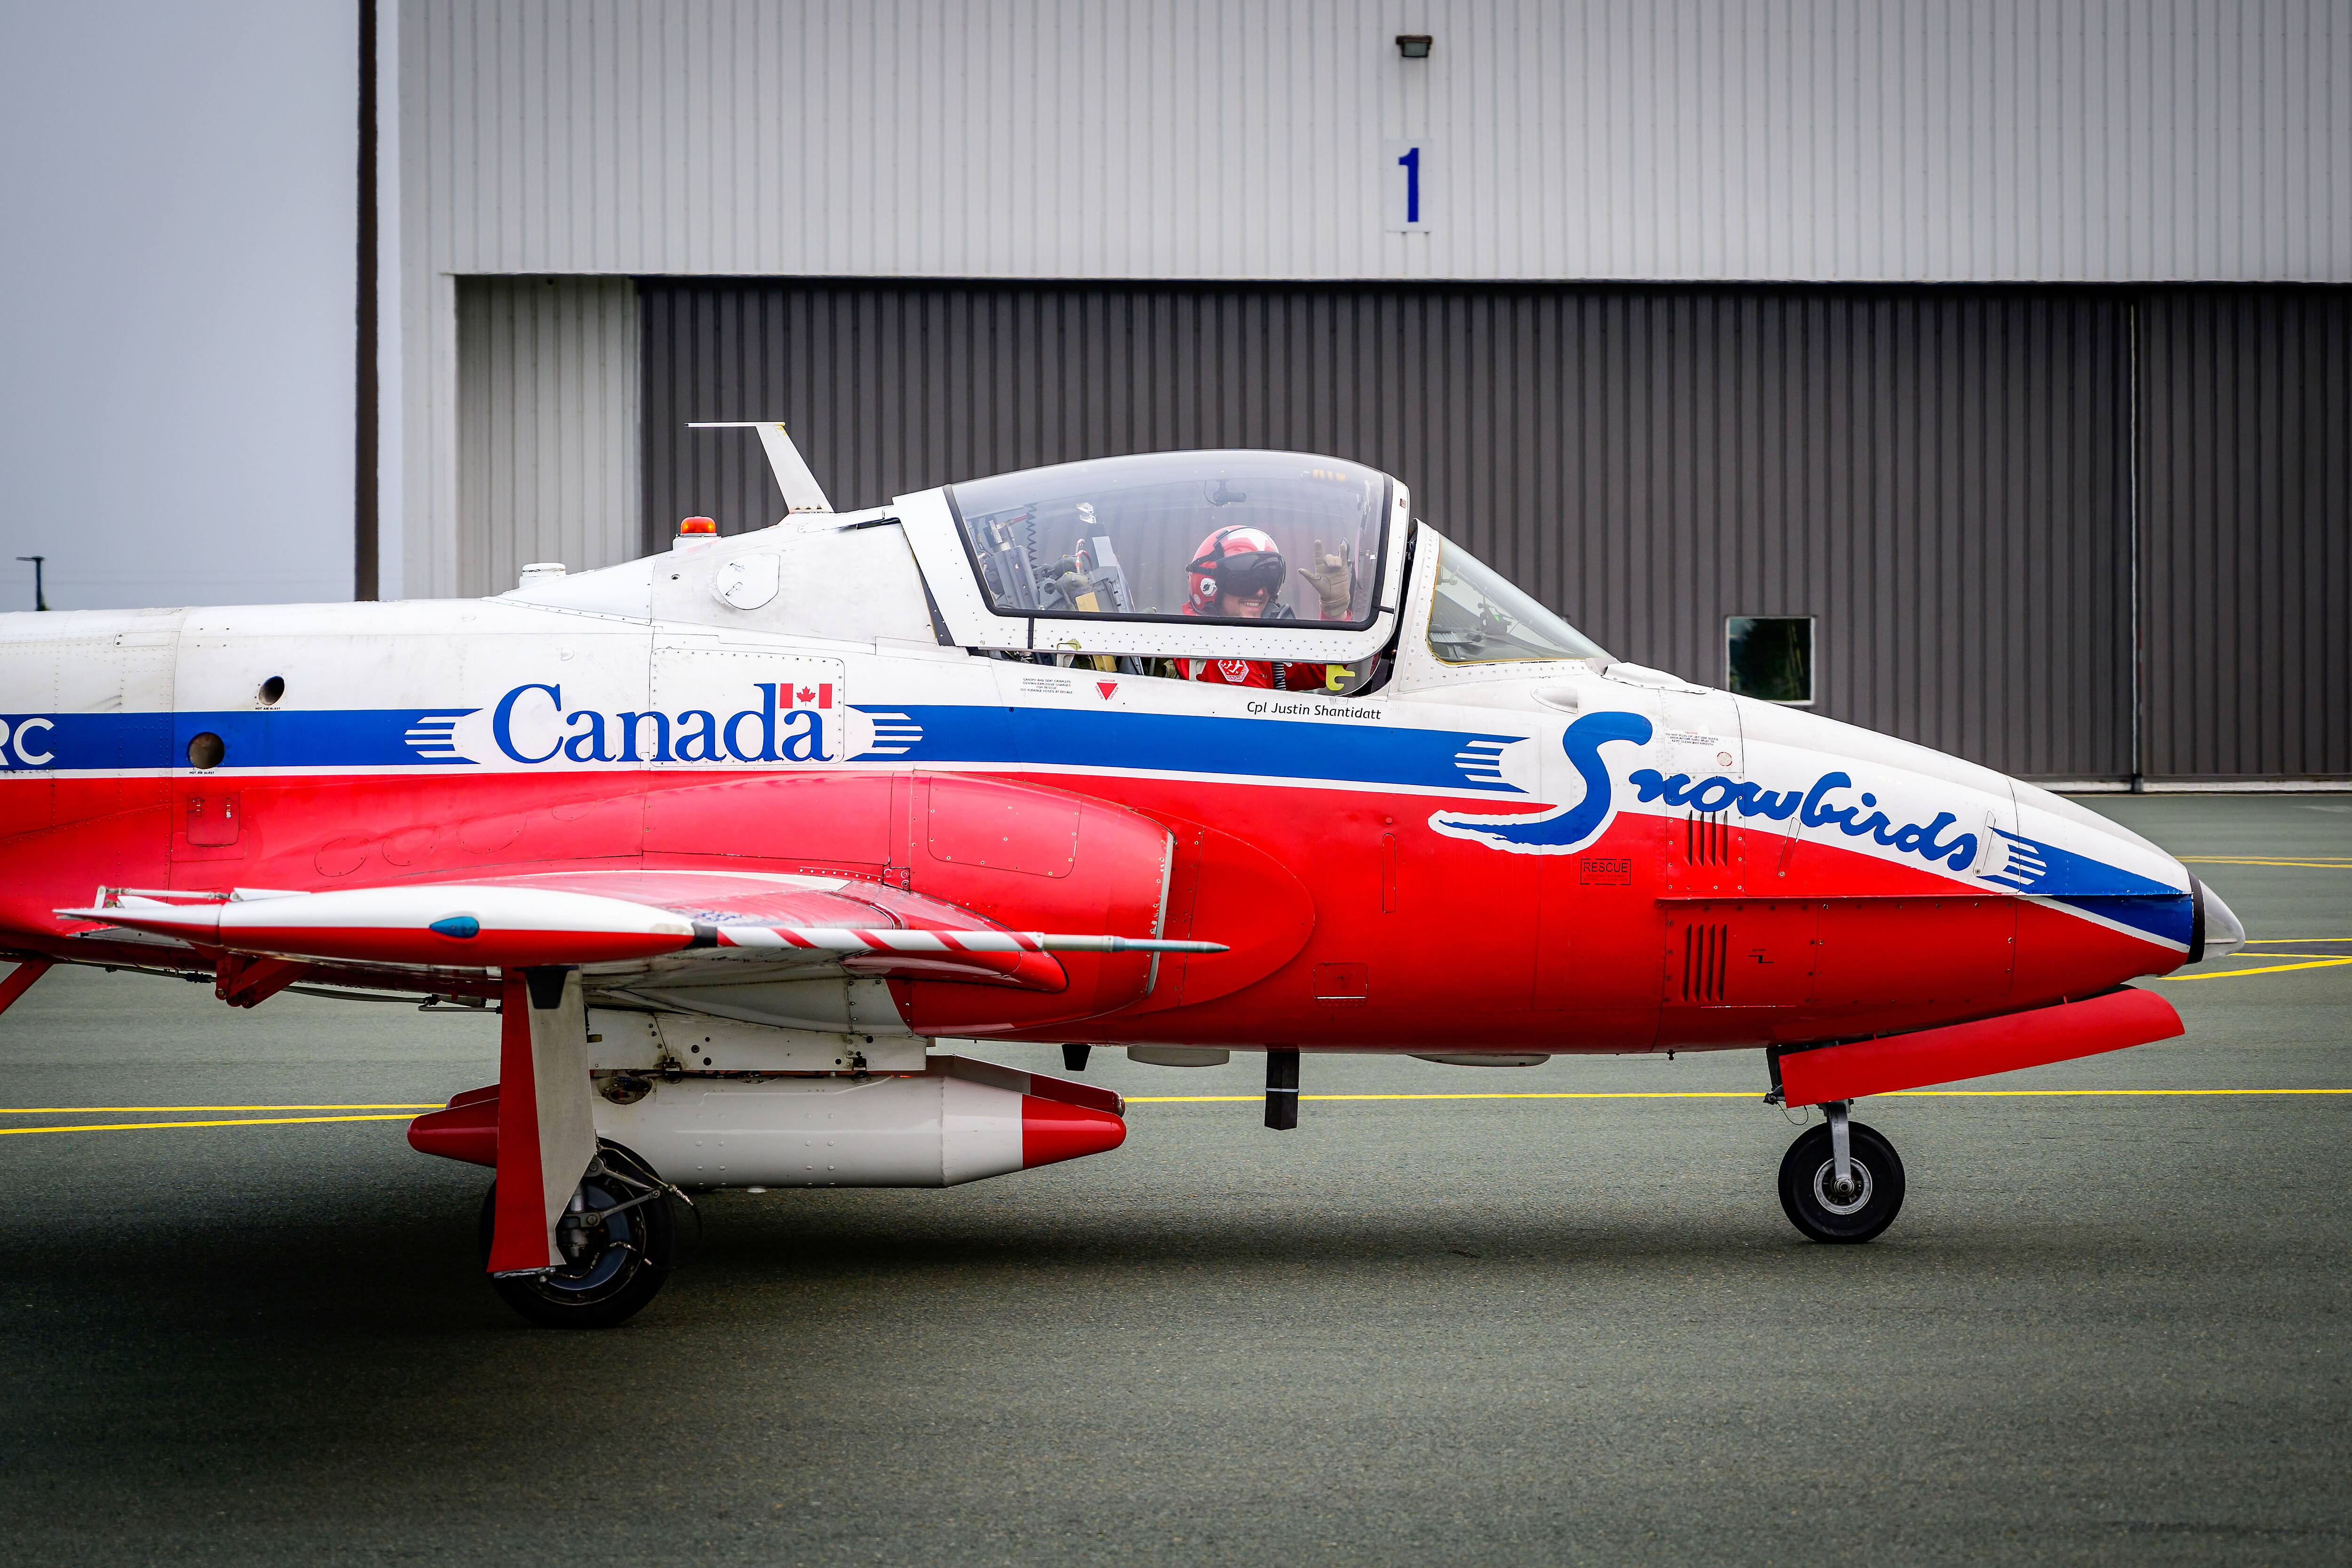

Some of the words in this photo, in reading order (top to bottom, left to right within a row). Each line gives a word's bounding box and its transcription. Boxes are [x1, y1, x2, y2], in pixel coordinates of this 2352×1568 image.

[1398, 148, 1419, 222] 1
[493, 684, 834, 763] Canada
[1247, 701, 1267, 715] Cpl
[1271, 703, 1310, 715] Justin
[1314, 705, 1381, 719] Shantidatt
[1439, 712, 1977, 872] Snowbirds
[1583, 862, 1628, 873] RESCUE
